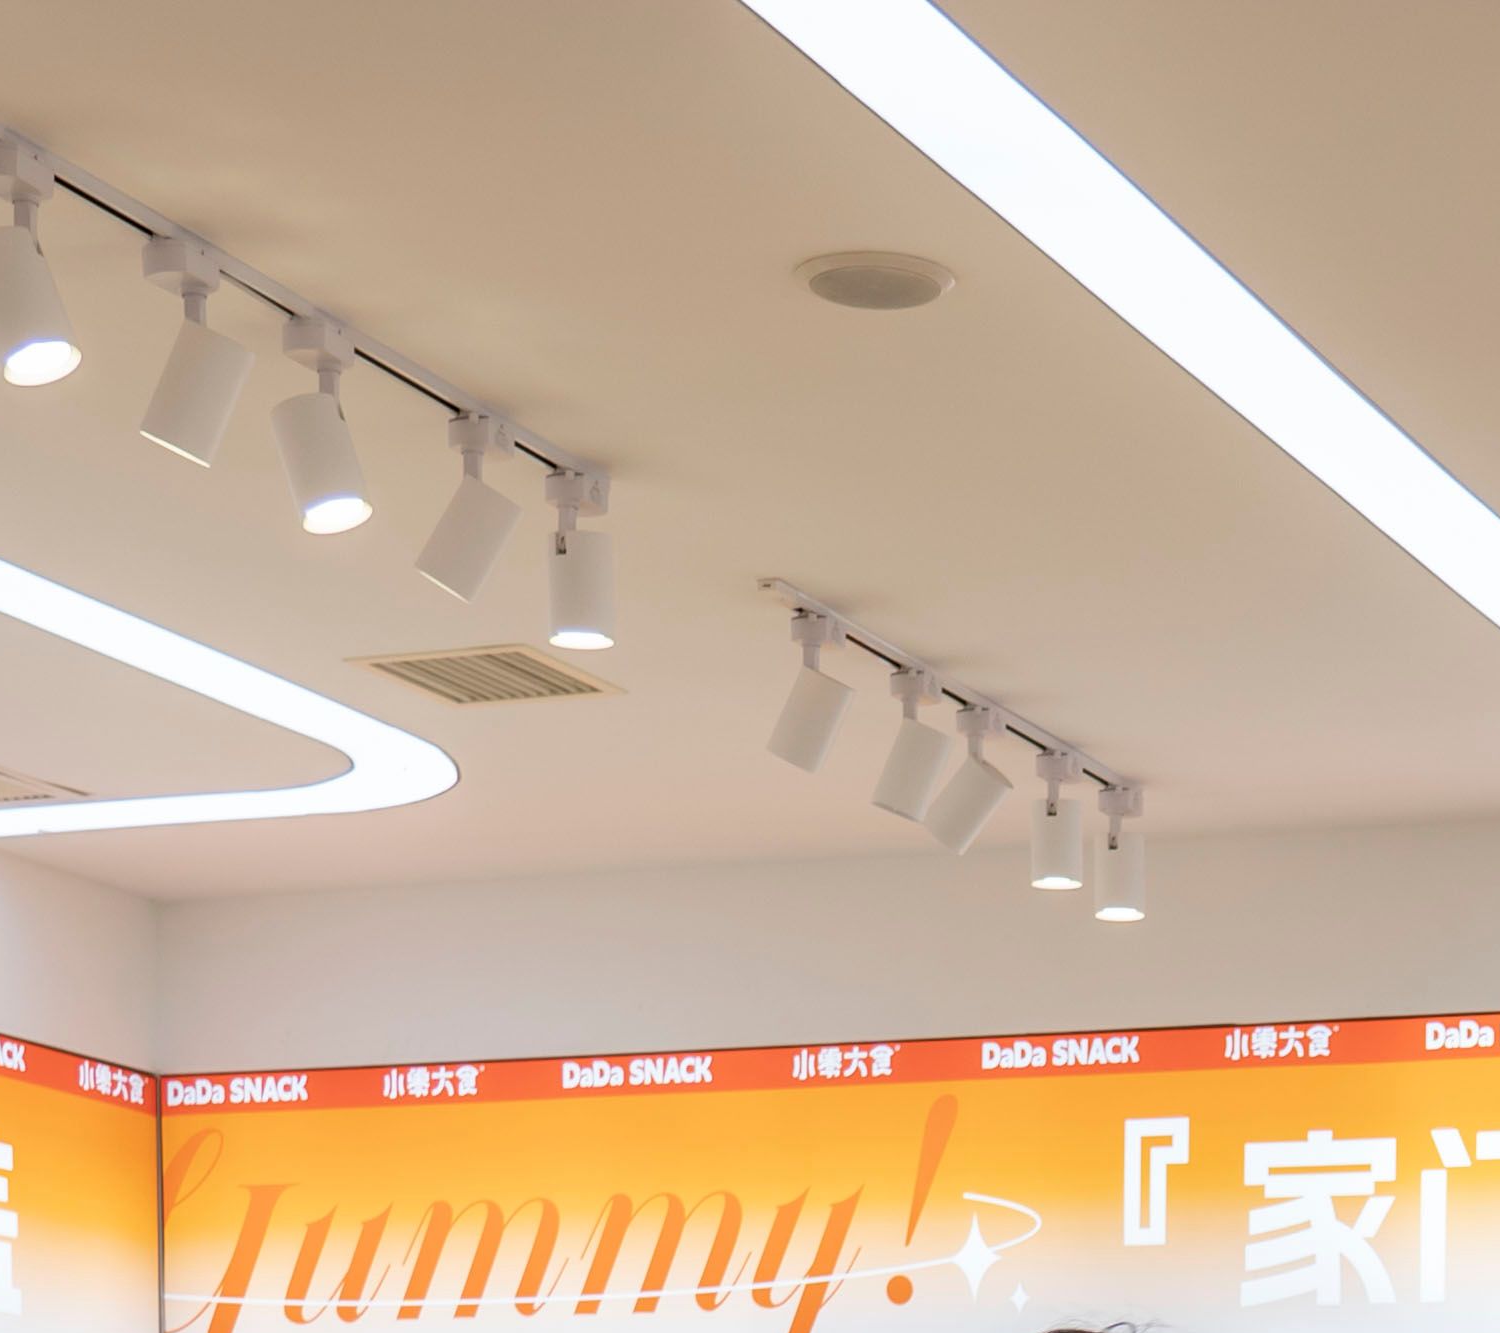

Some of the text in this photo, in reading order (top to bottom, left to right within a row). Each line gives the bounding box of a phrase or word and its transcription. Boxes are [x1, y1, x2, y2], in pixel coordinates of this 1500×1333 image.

[1225, 1026, 1331, 1060] 小零大食
[1425, 1020, 1494, 1051] DaDa
[793, 1046, 893, 1079] 小零大食
[982, 1036, 1140, 1070] DaDa SNACK
[79, 1061, 145, 1104] 小零大食
[383, 1066, 480, 1098] 小零大食
[562, 1055, 713, 1090] DaDa SNACK
[167, 1074, 308, 1106] DaDa SNACK
